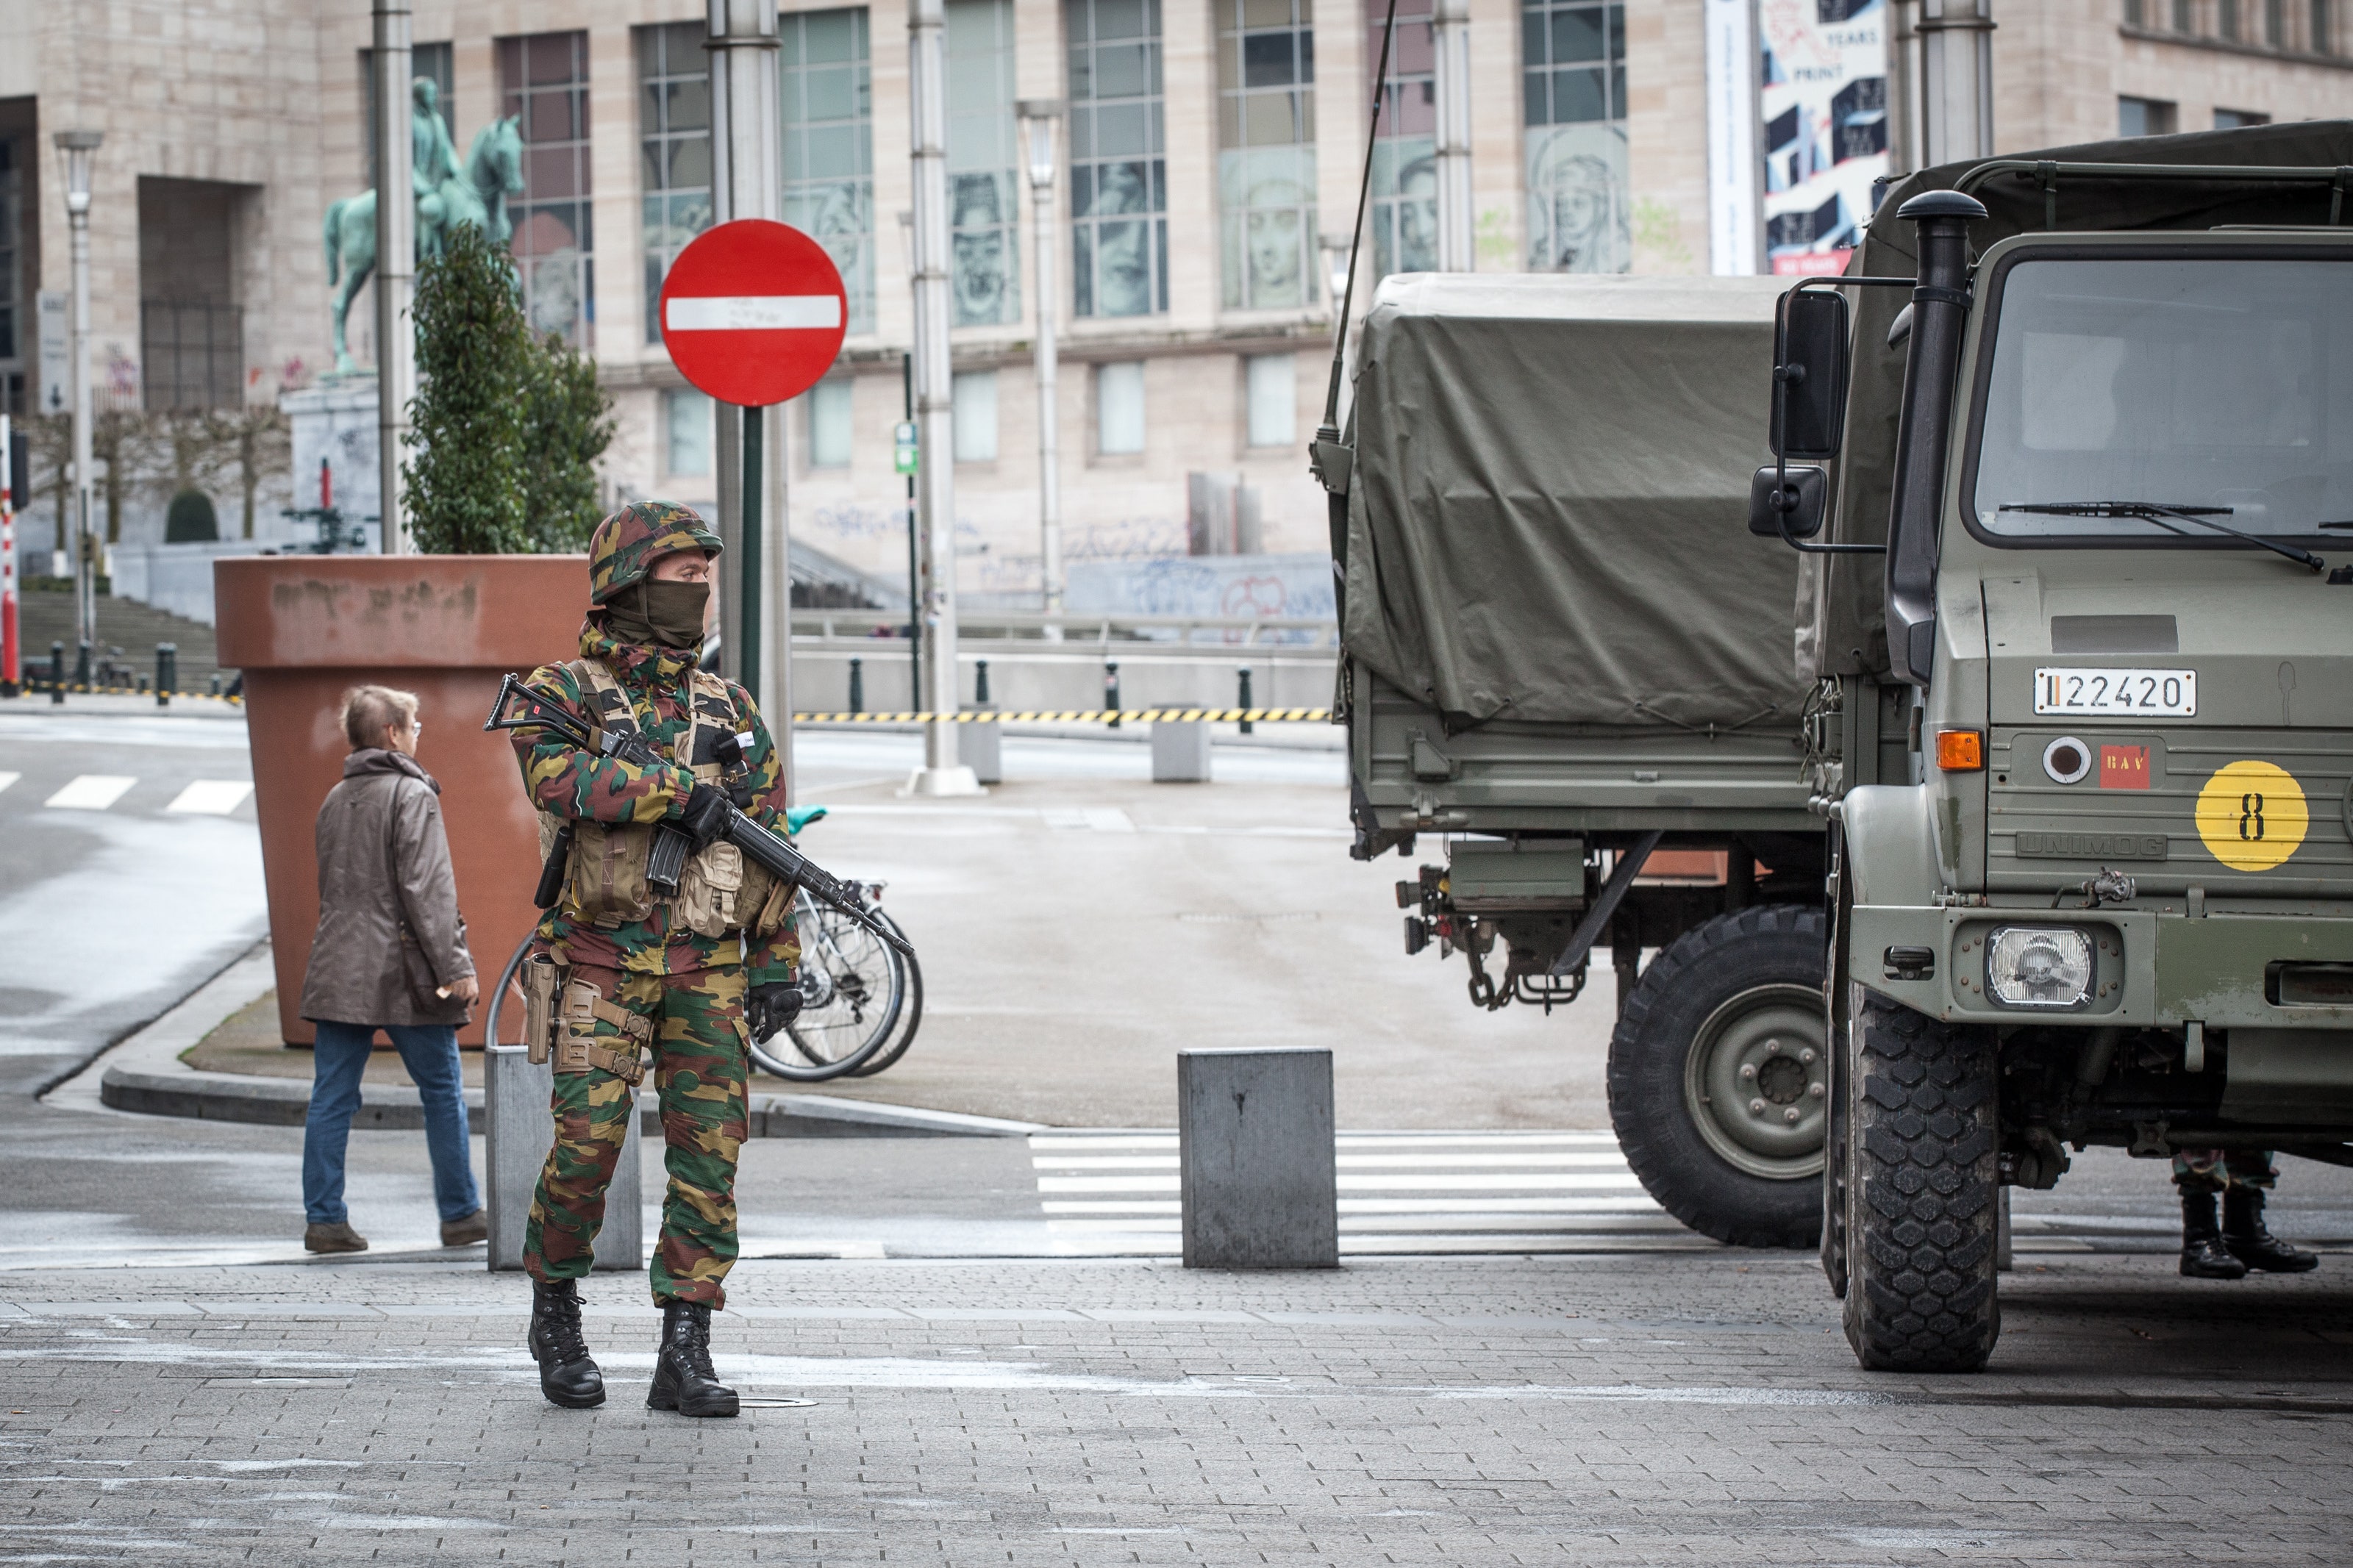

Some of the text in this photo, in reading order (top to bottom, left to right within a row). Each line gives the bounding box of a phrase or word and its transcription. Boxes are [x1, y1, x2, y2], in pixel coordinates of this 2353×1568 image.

[2066, 676, 2181, 708] 22420
[2239, 793, 2264, 840] 8
[2019, 835, 2164, 856] UNIMOG
